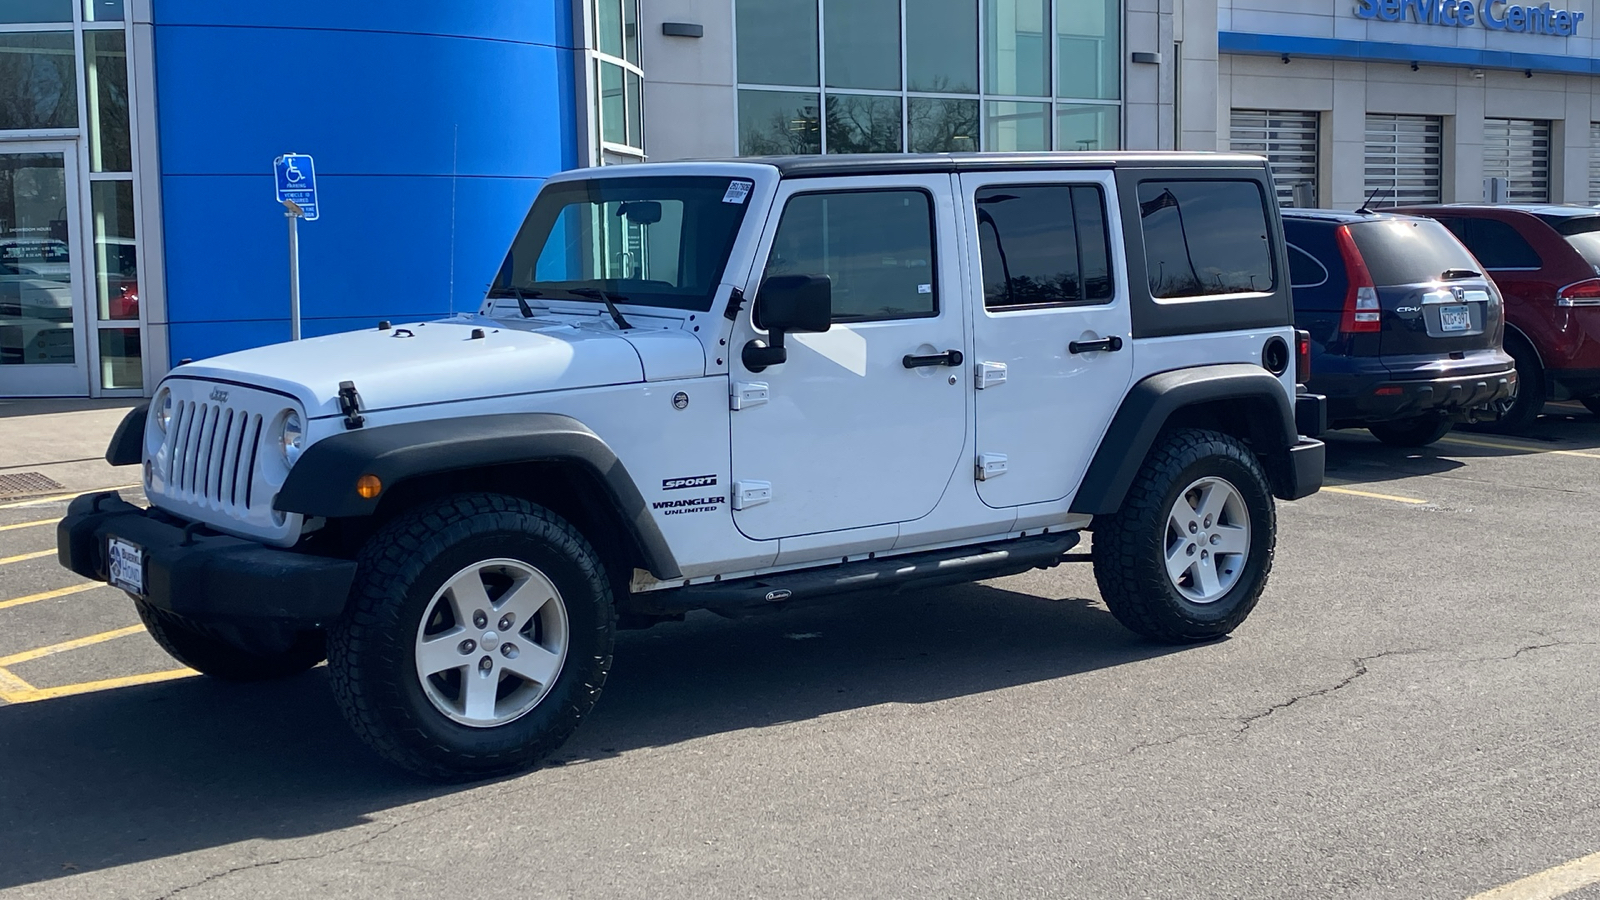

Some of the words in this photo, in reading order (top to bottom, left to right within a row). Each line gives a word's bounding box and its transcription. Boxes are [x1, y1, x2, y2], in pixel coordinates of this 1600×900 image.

[1354, 0, 1475, 26] Service
[1480, 0, 1584, 36] Center
[666, 477, 714, 488] SPORT
[652, 496, 726, 509] WRANGLER
[664, 506, 718, 516] UNLIMITED
[122, 548, 140, 565] BUERKL
[122, 560, 140, 582] HOND
